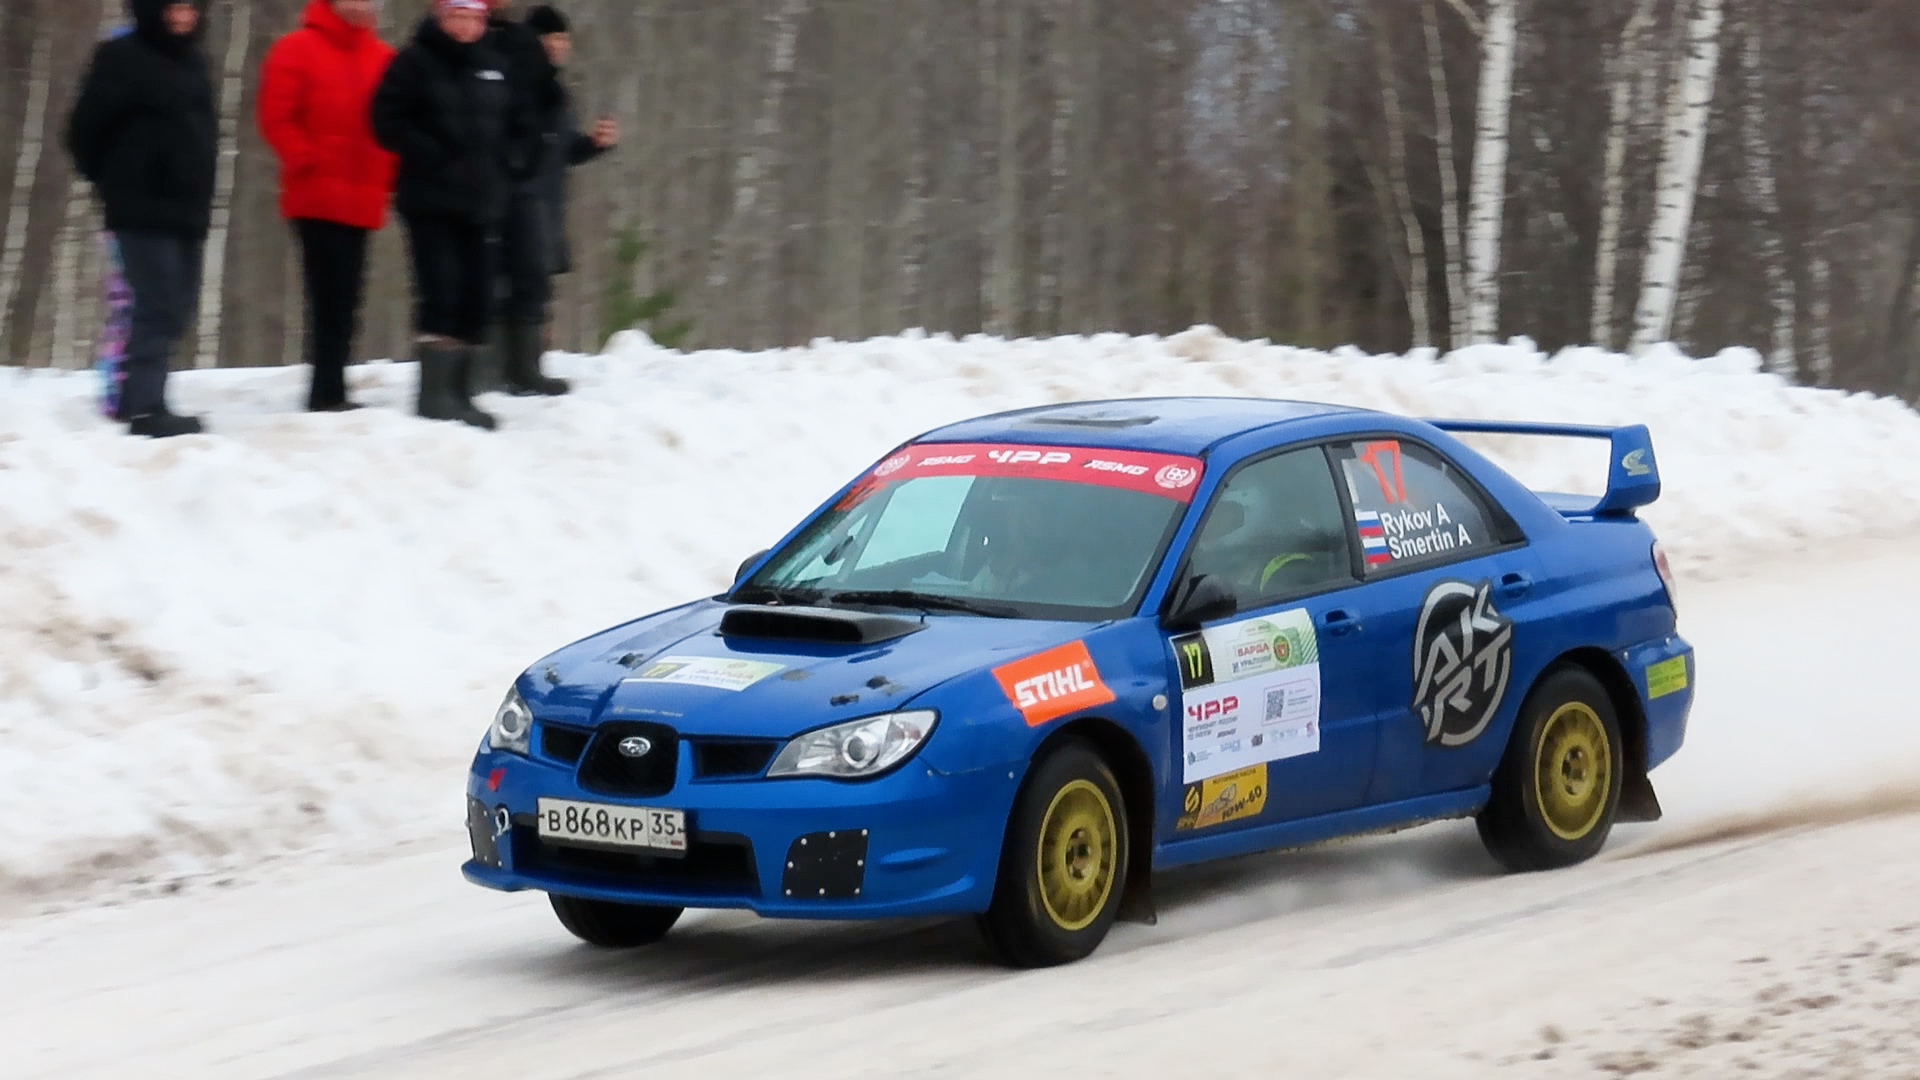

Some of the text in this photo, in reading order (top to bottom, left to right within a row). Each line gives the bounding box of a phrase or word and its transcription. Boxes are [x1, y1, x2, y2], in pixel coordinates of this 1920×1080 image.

[1360, 440, 1407, 504] 17
[1380, 502, 1451, 538] Rykov A
[1389, 523, 1473, 559] Smertin A
[1182, 642, 1203, 680] 17
[1013, 663, 1095, 708] STIHL
[651, 812, 677, 836] 35
